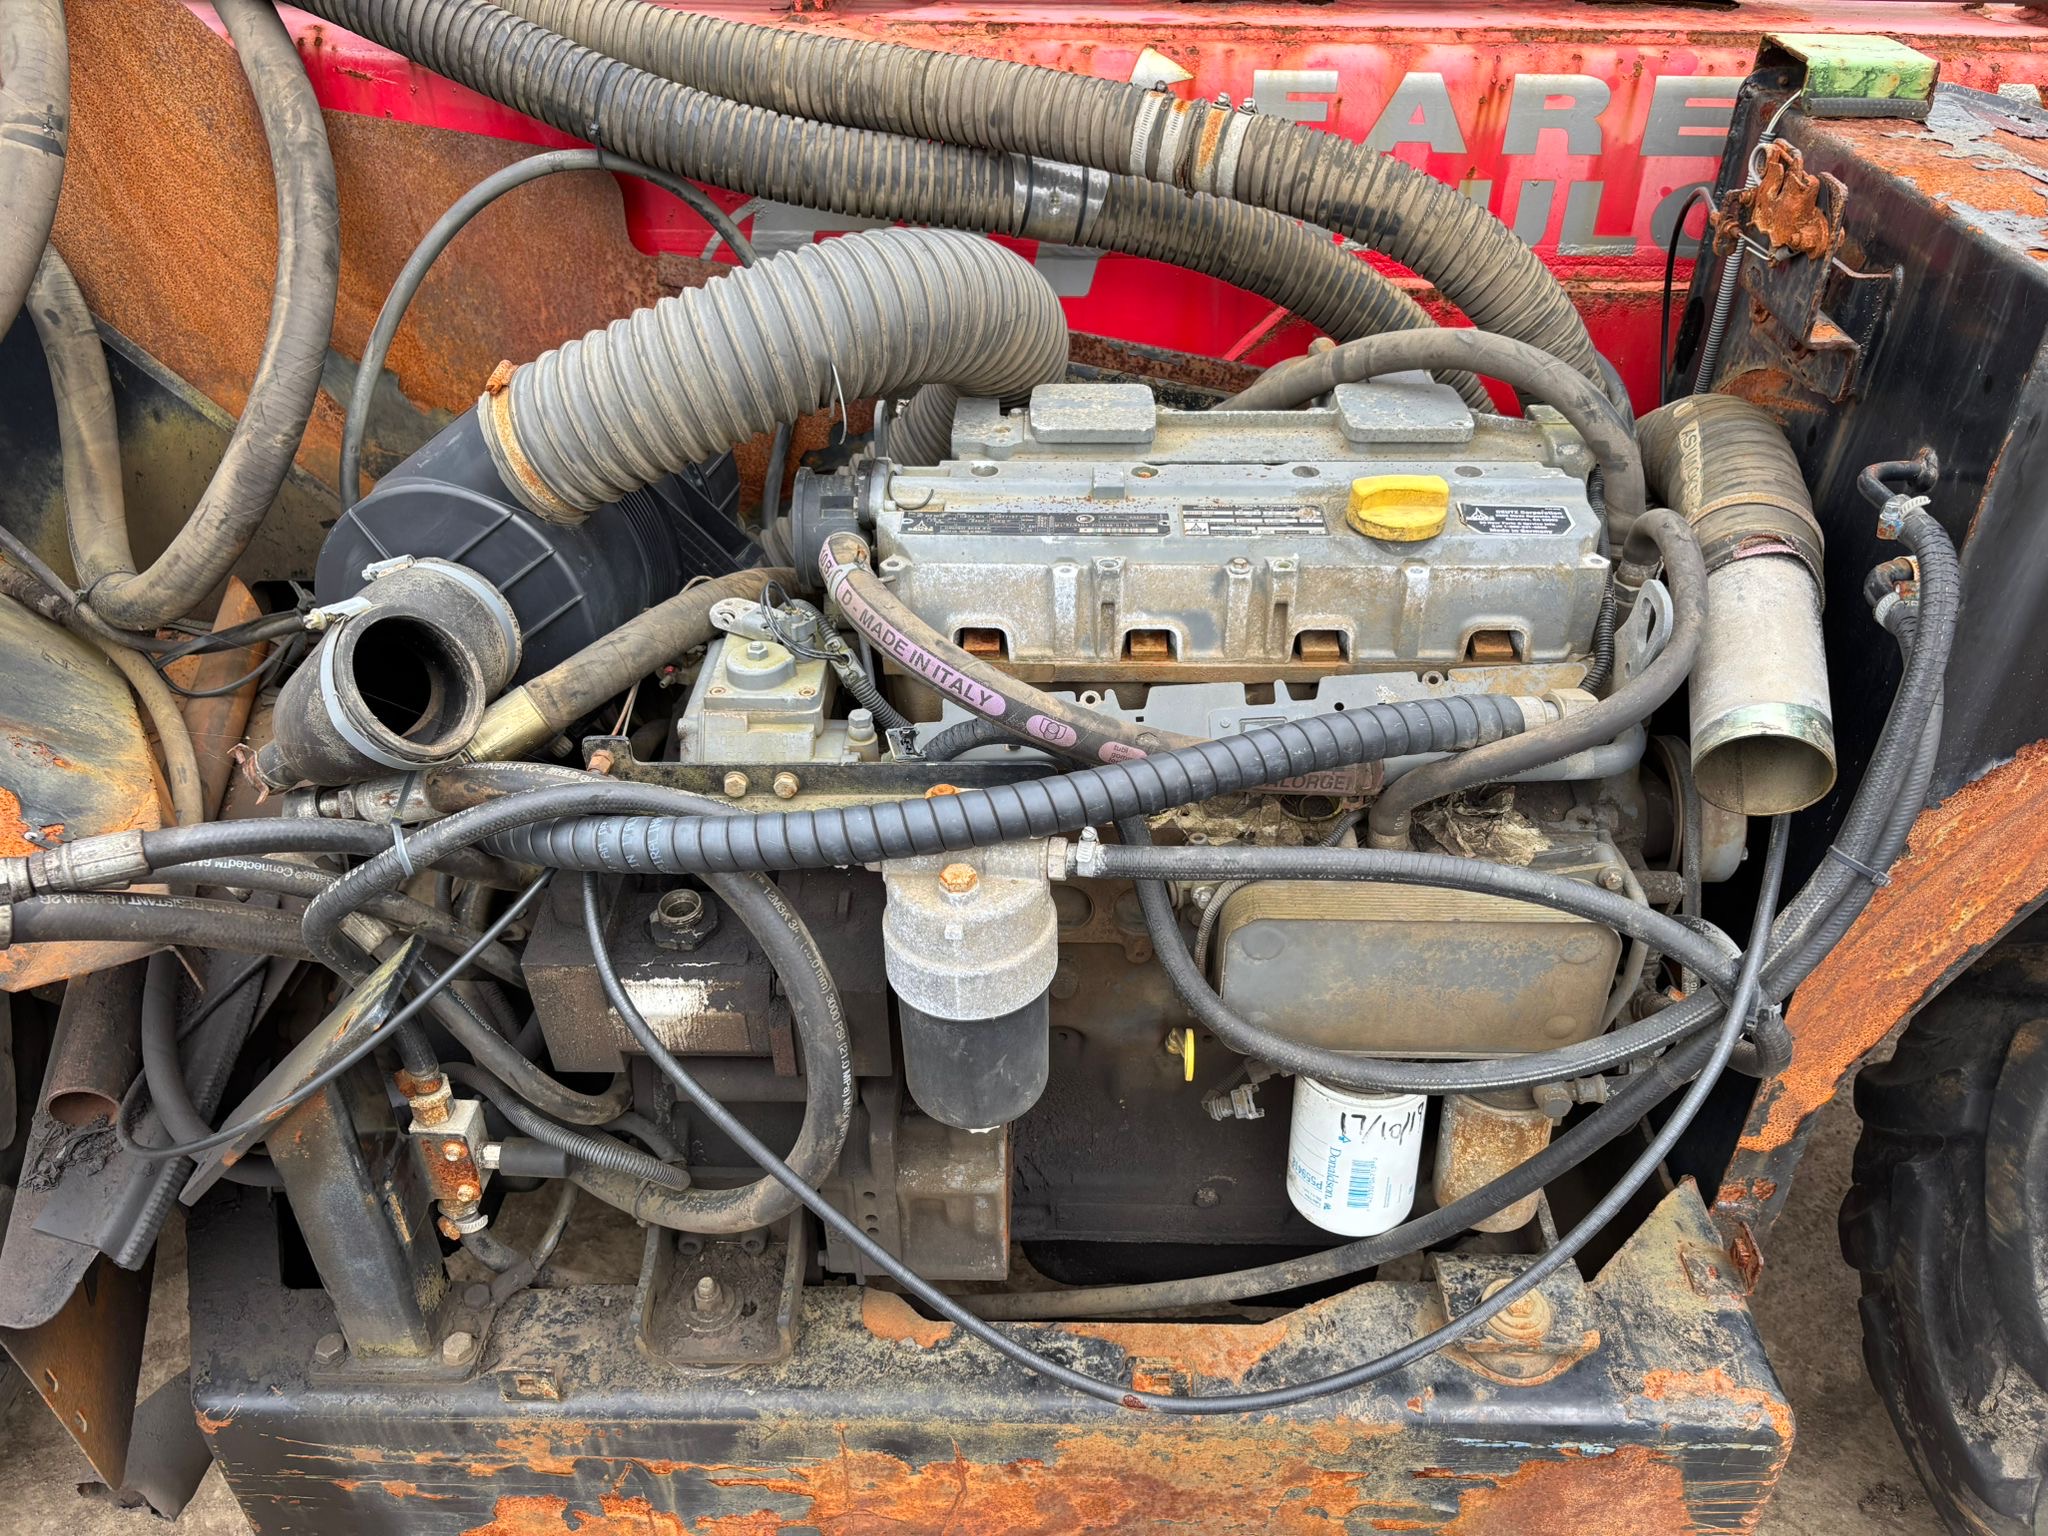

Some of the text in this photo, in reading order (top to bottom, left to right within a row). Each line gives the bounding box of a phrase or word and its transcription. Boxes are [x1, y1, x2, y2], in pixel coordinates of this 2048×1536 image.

[858, 611, 910, 658] MADE
[907, 647, 932, 673] IN
[930, 665, 994, 707] ITALY
[825, 992, 842, 1022] 3000
